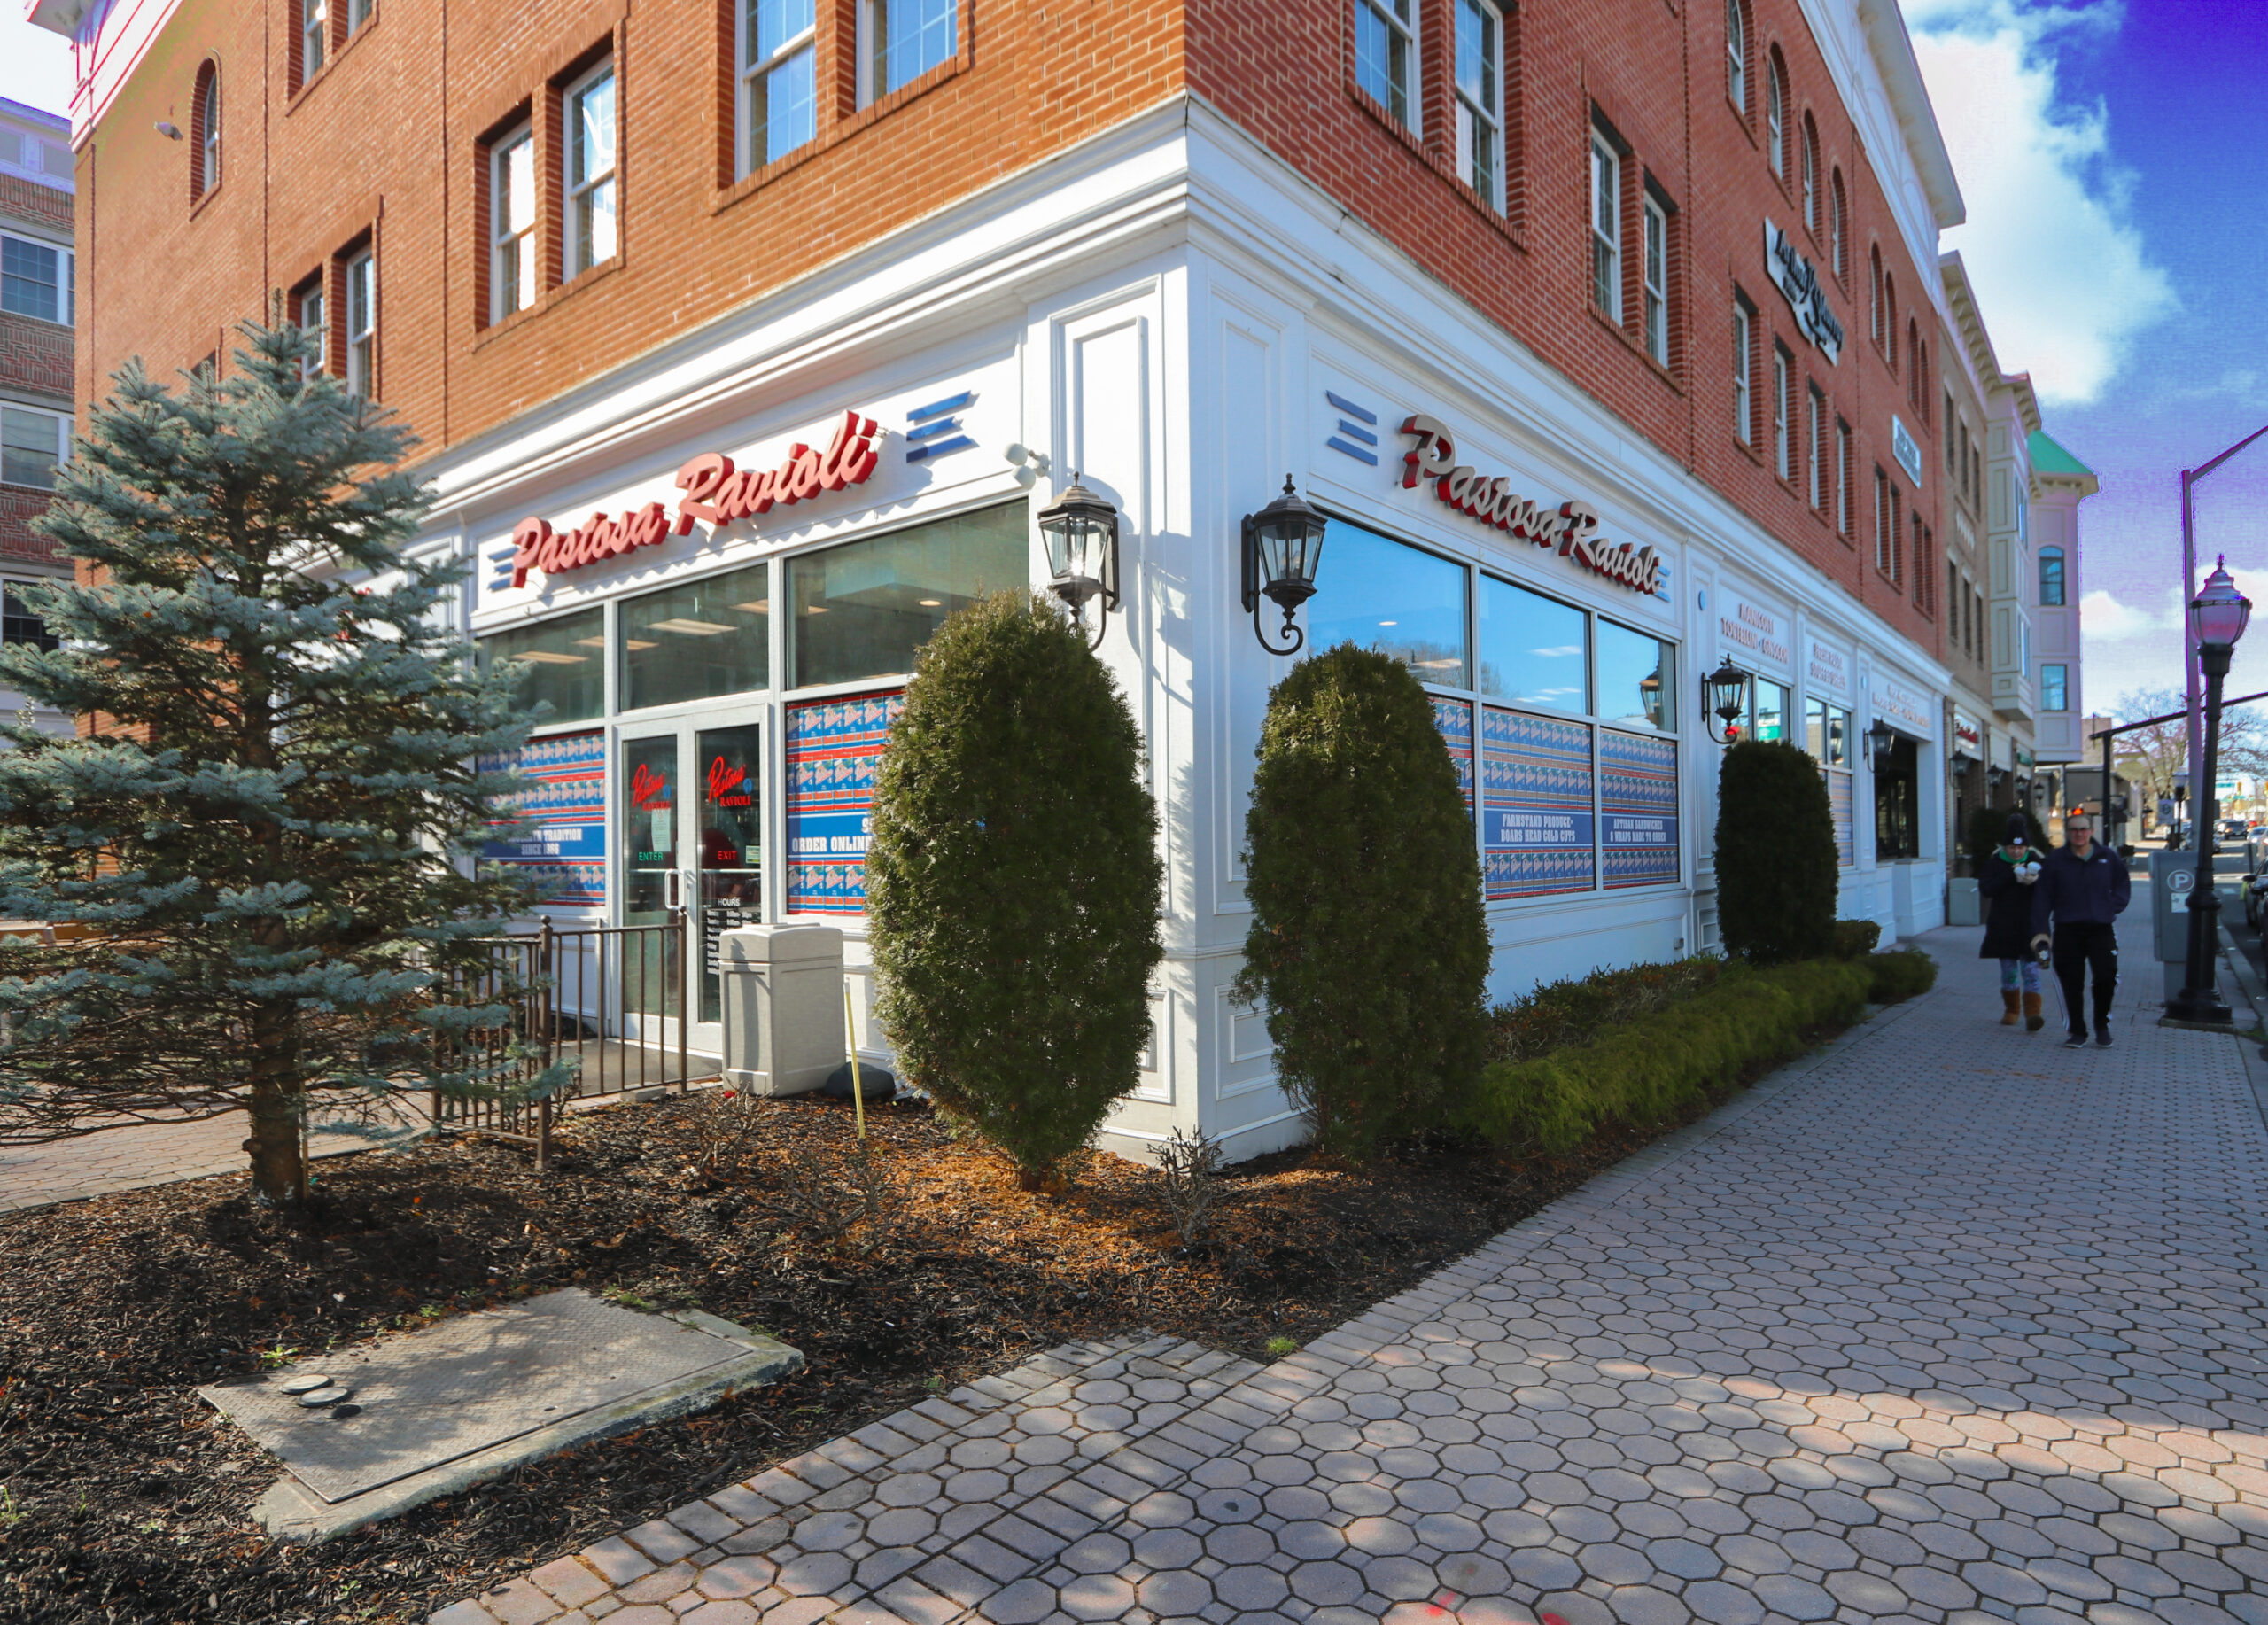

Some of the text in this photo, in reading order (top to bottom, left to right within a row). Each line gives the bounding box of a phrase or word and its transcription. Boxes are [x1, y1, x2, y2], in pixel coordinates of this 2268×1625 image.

[510, 409, 878, 588] Pastosa Ravioli
[1400, 414, 1662, 595] Pastosa Ravioli
[719, 795, 751, 807] RAVIOLI
[1502, 813, 1542, 828] FARMSTAND
[543, 828, 583, 841] TRADITION
[1525, 829, 1542, 842] HEAD
[1543, 829, 1559, 842] COLD
[1560, 830, 1576, 842] CUTS
[792, 836, 827, 852] ORDER
[639, 851, 664, 861] ENTER
[717, 851, 737, 860] EXIT
[718, 898, 741, 906] HOURS
